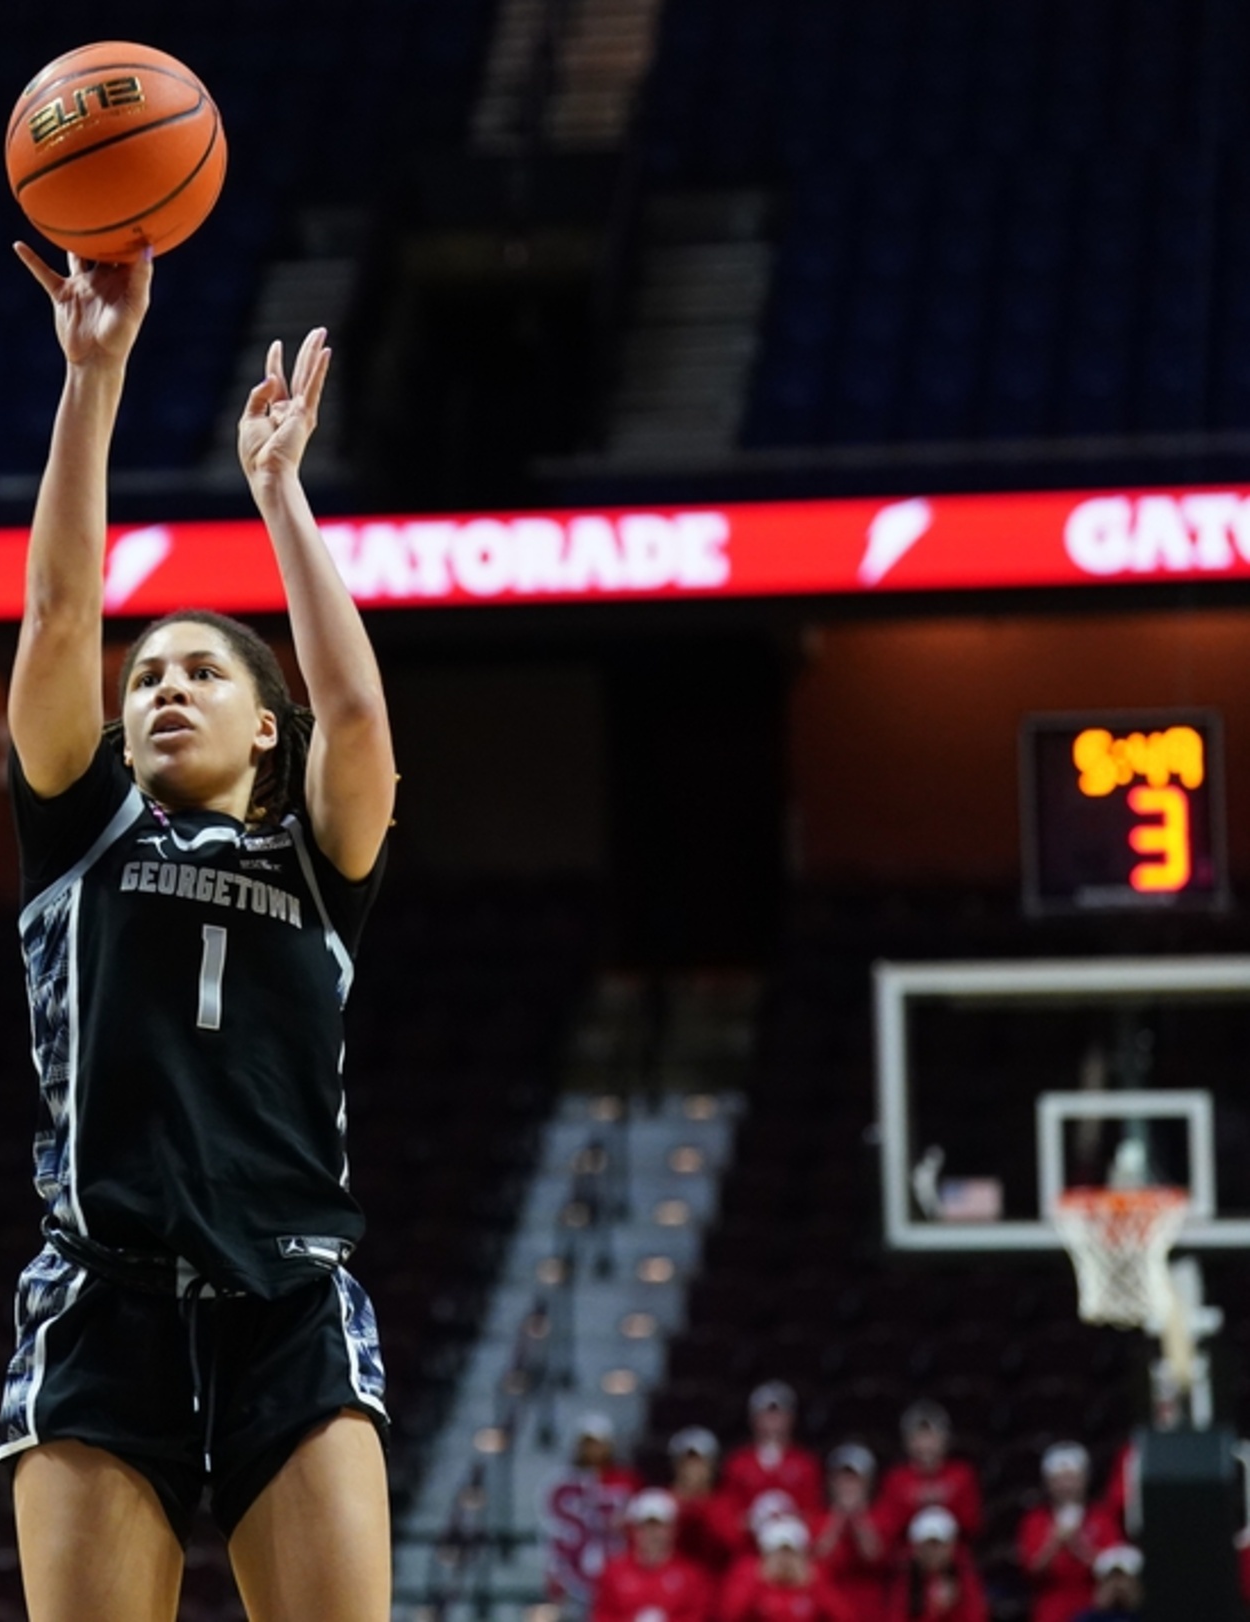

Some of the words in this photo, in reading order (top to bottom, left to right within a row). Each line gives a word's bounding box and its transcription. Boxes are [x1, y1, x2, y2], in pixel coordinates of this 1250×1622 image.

[28, 76, 146, 144] ELITE
[1126, 784, 1192, 893] 3
[120, 861, 303, 930] GEORGETOWN
[196, 923, 228, 1030] 1
